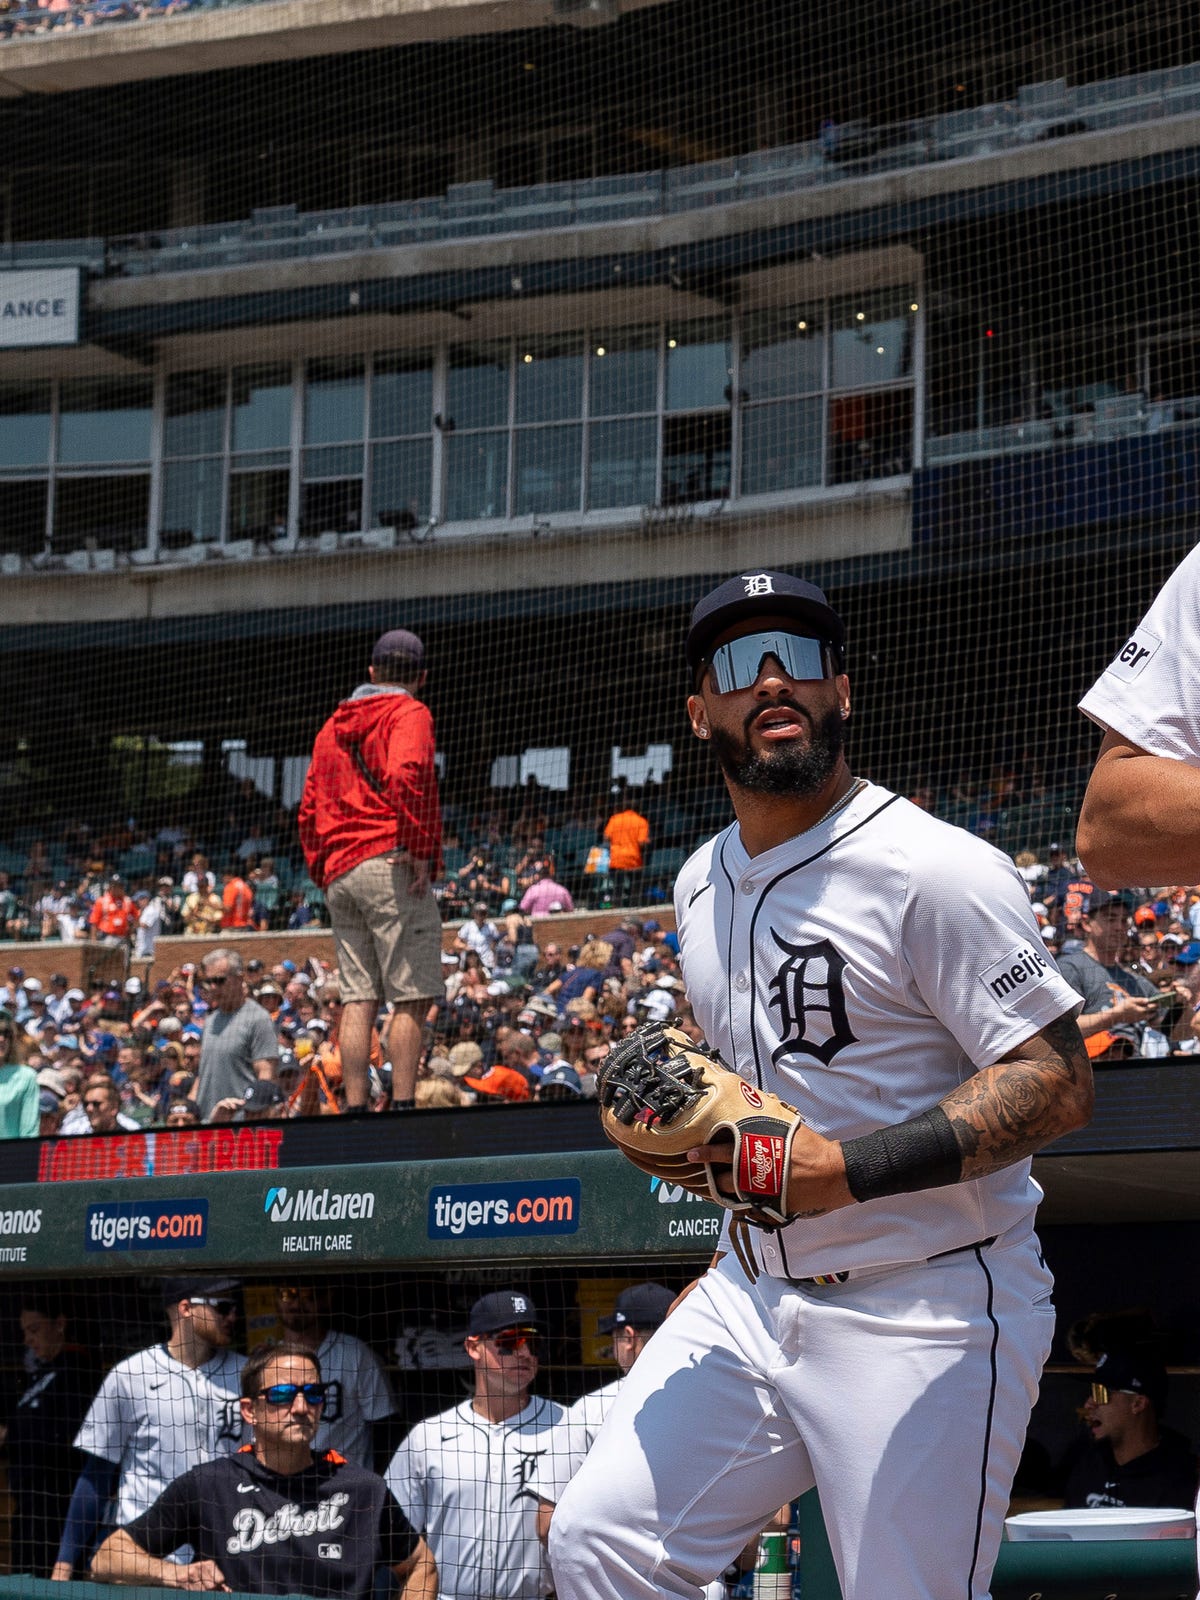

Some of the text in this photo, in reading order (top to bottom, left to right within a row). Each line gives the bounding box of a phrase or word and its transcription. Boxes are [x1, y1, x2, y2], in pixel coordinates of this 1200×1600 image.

[2, 298, 66, 317] ANCE
[741, 573, 775, 597] D
[989, 949, 1048, 999] meije
[768, 925, 860, 1075] D
[751, 1139, 770, 1190] Rawlings
[293, 1188, 375, 1222] McLaren
[434, 1194, 574, 1235] tigers.com
[90, 1211, 204, 1248] tigers.com
[282, 1234, 353, 1252] HEALTH CARE
[668, 1218, 719, 1237] CANCER
[226, 1491, 350, 1555] Detroit
